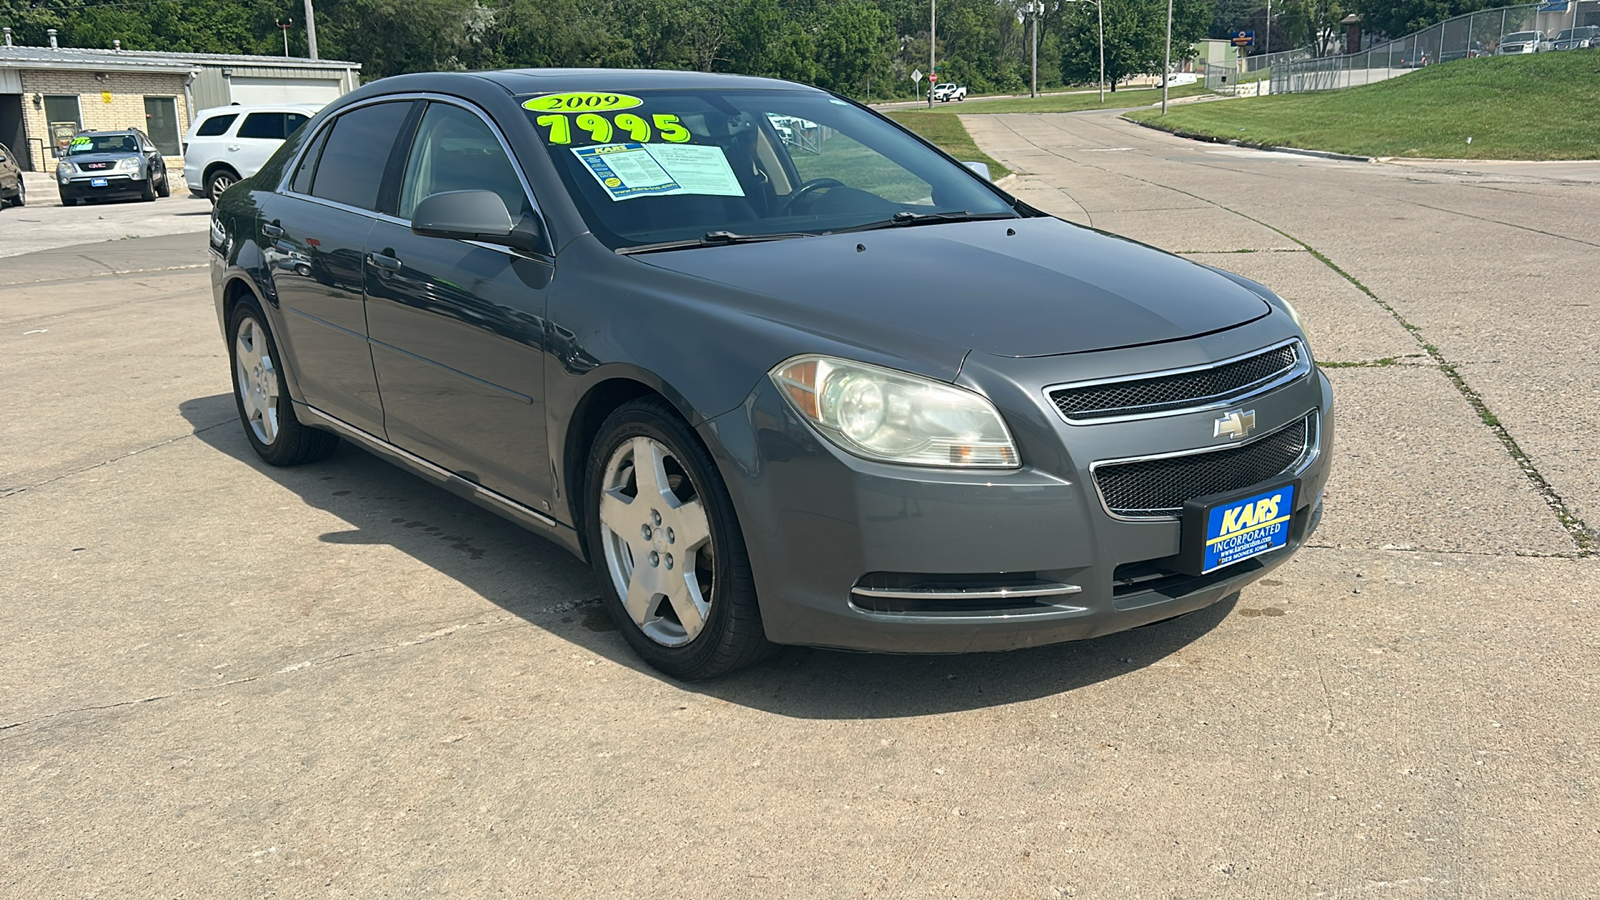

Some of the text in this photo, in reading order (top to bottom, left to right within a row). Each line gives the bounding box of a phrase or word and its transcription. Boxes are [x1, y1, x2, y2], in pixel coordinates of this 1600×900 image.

[547, 95, 620, 110] 2009
[536, 113, 691, 144] 7995
[594, 145, 628, 155] KARS
[1219, 494, 1282, 536] KARS
[1213, 523, 1281, 553] INCORPORATED
